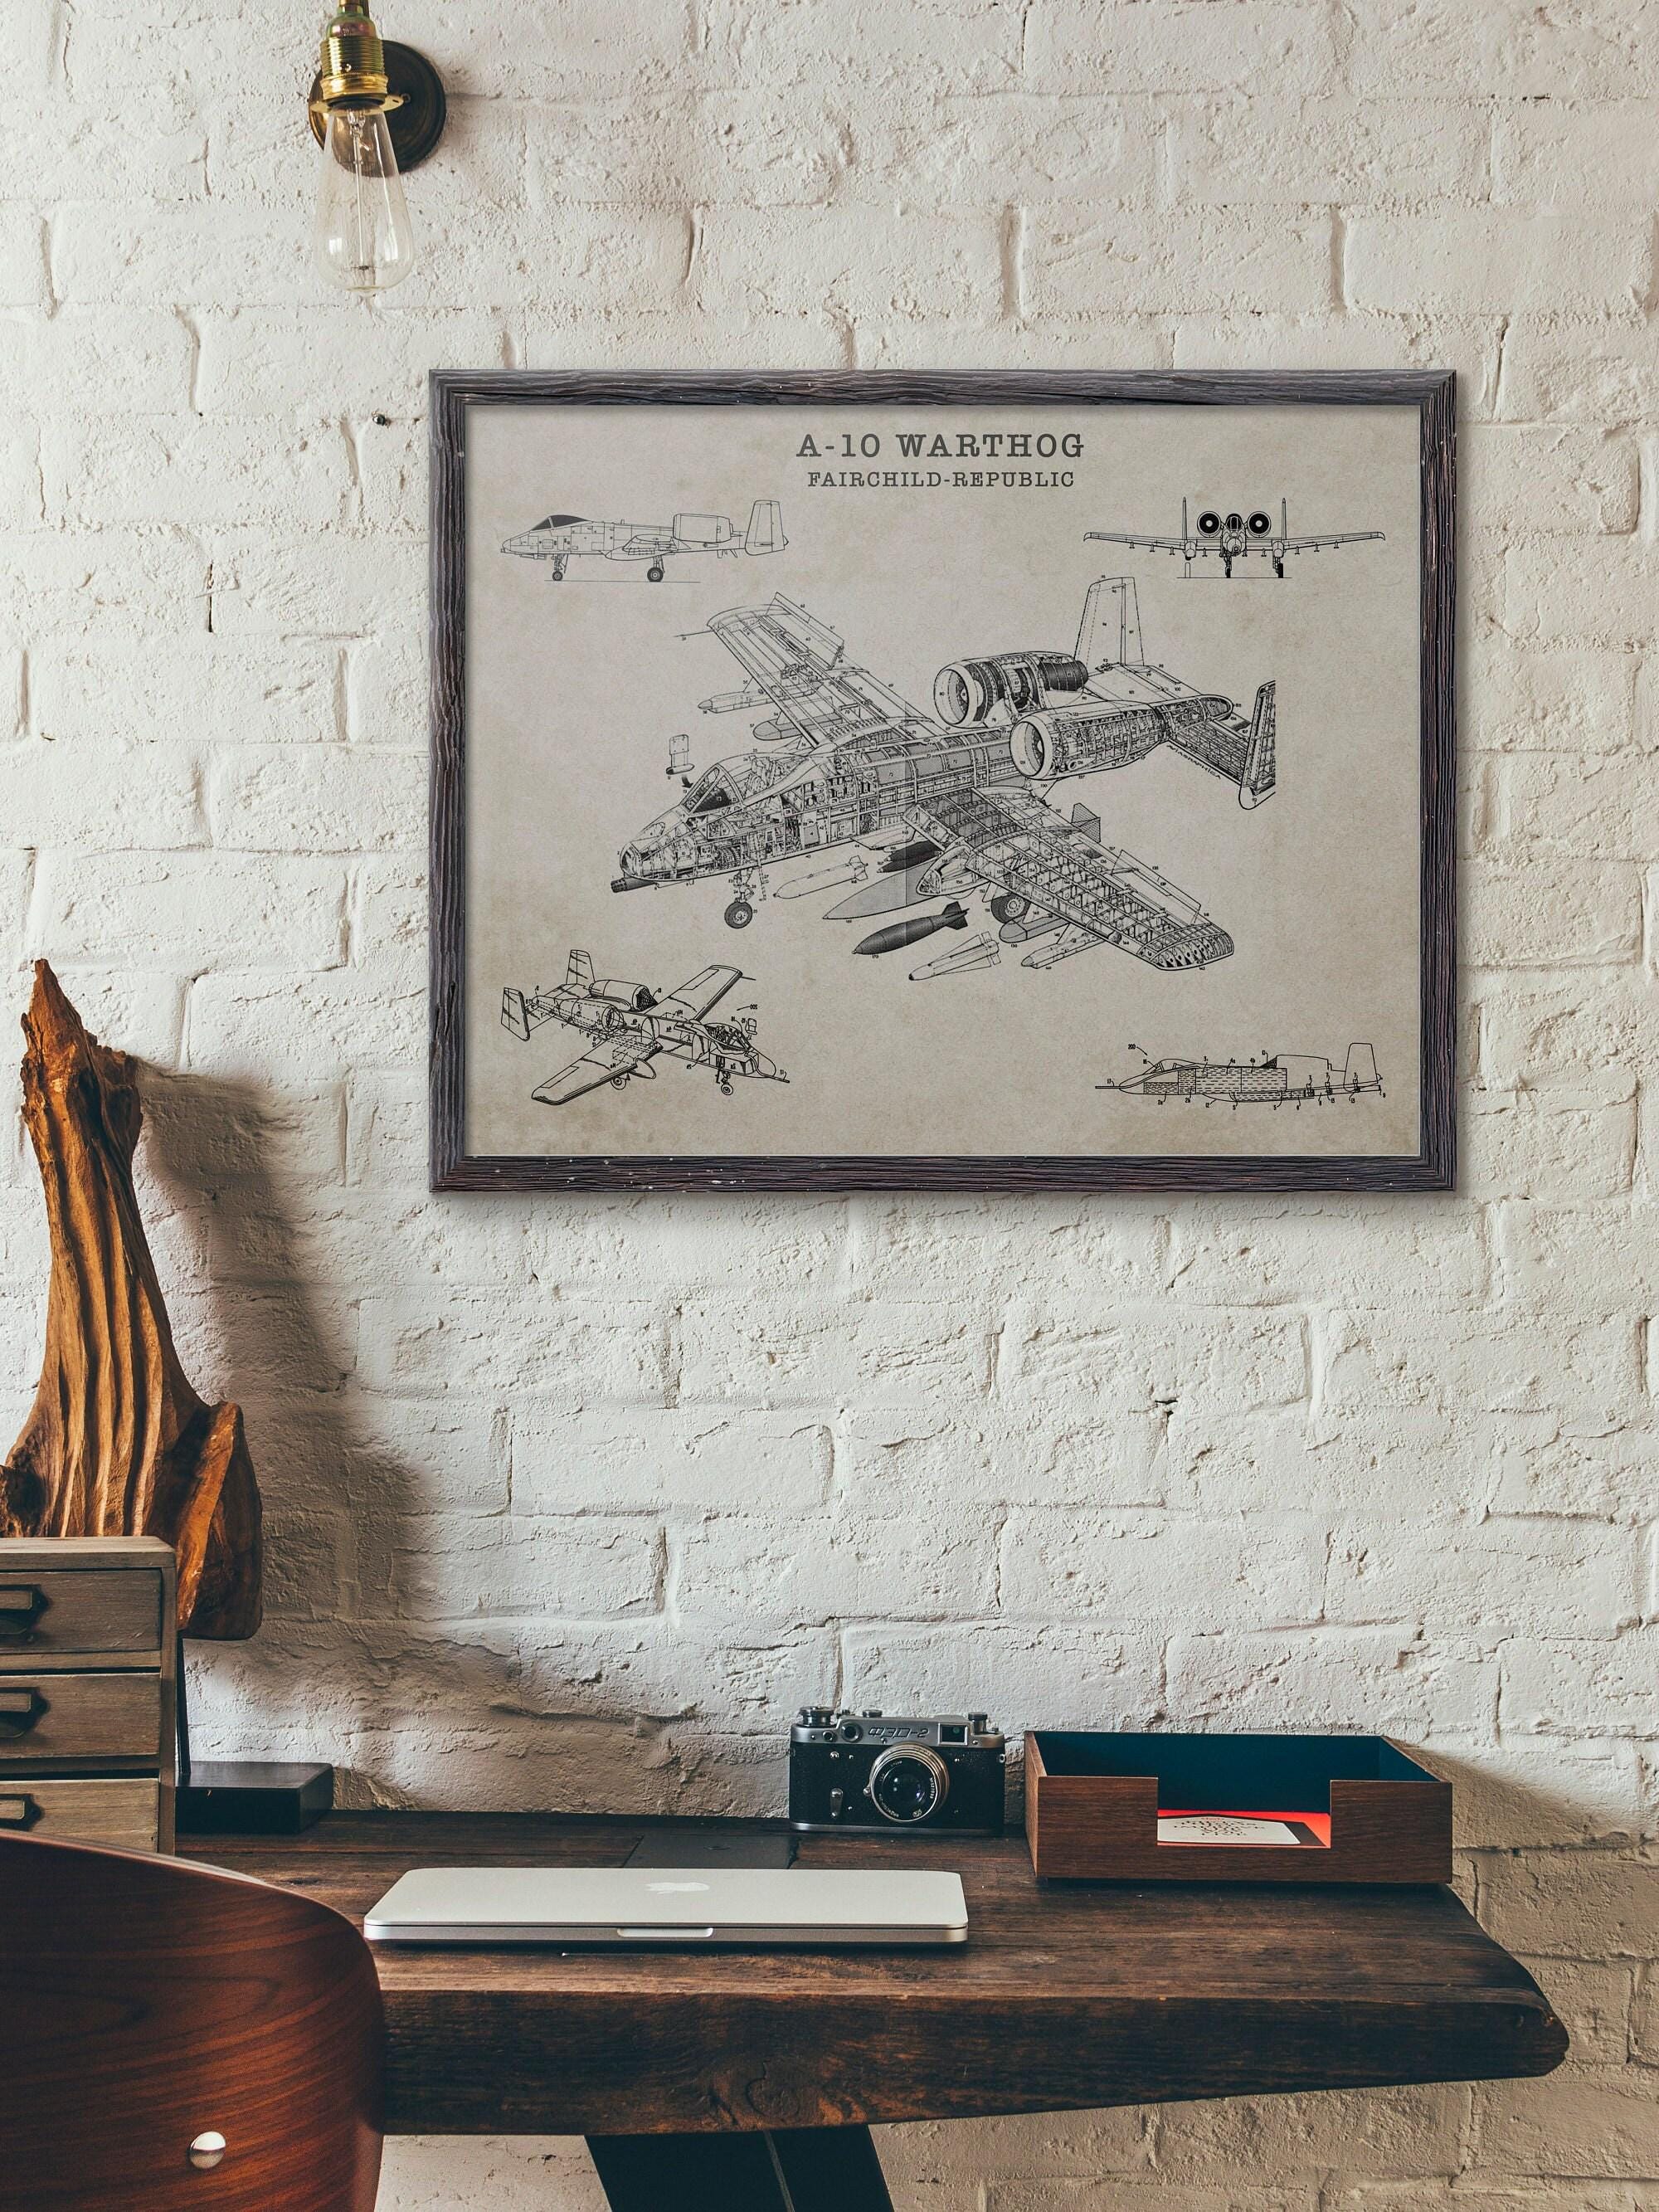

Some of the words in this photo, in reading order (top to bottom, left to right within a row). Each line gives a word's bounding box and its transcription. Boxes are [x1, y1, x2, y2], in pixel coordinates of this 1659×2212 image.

[795, 433, 880, 458] A-10
[895, 433, 1084, 458] WARTHOG
[807, 471, 1075, 488] FAIRCHILD-REPUBLIC
